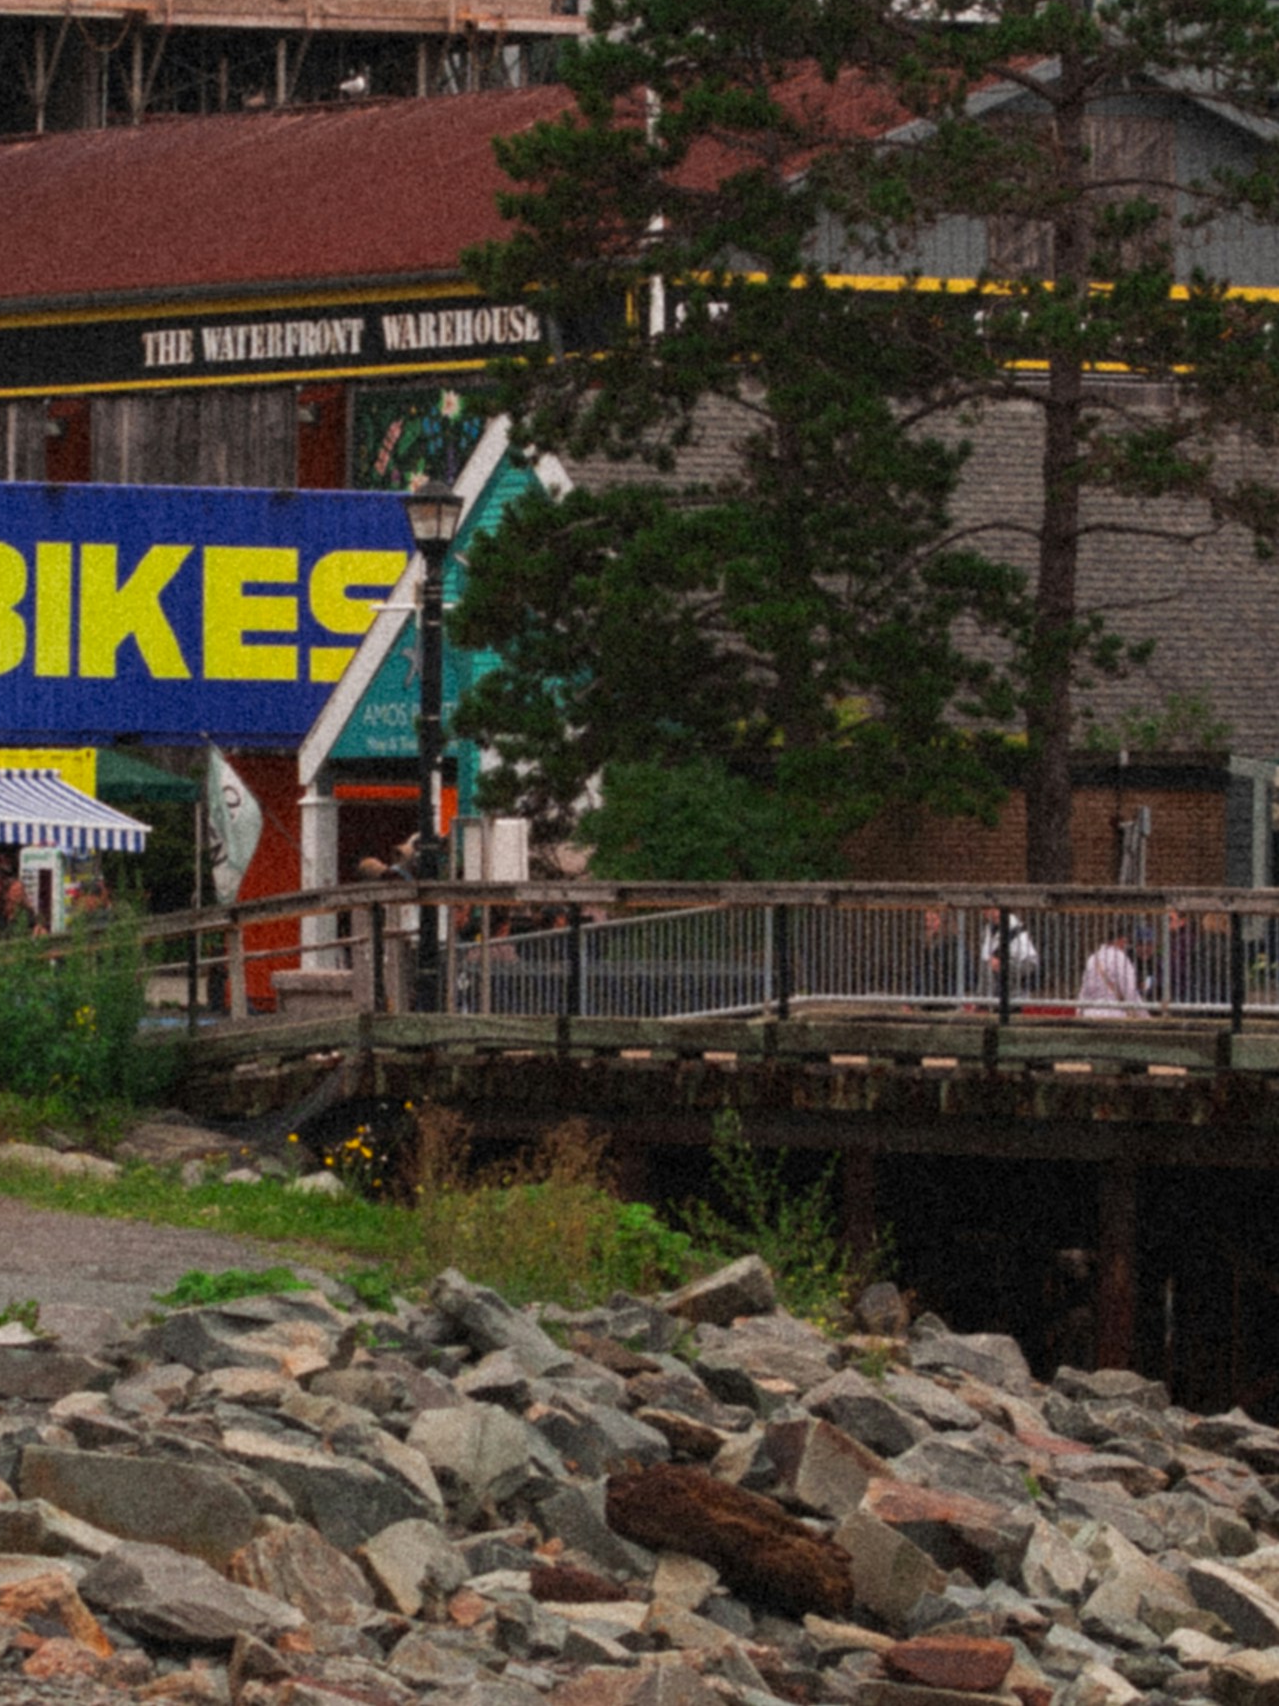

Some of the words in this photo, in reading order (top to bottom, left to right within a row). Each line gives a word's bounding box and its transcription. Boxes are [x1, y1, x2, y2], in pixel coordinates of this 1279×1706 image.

[142, 329, 194, 367] THE
[202, 318, 363, 362] WATERFRONT
[382, 305, 541, 350] WAREHOUSE
[363, 702, 408, 727] AMOS
